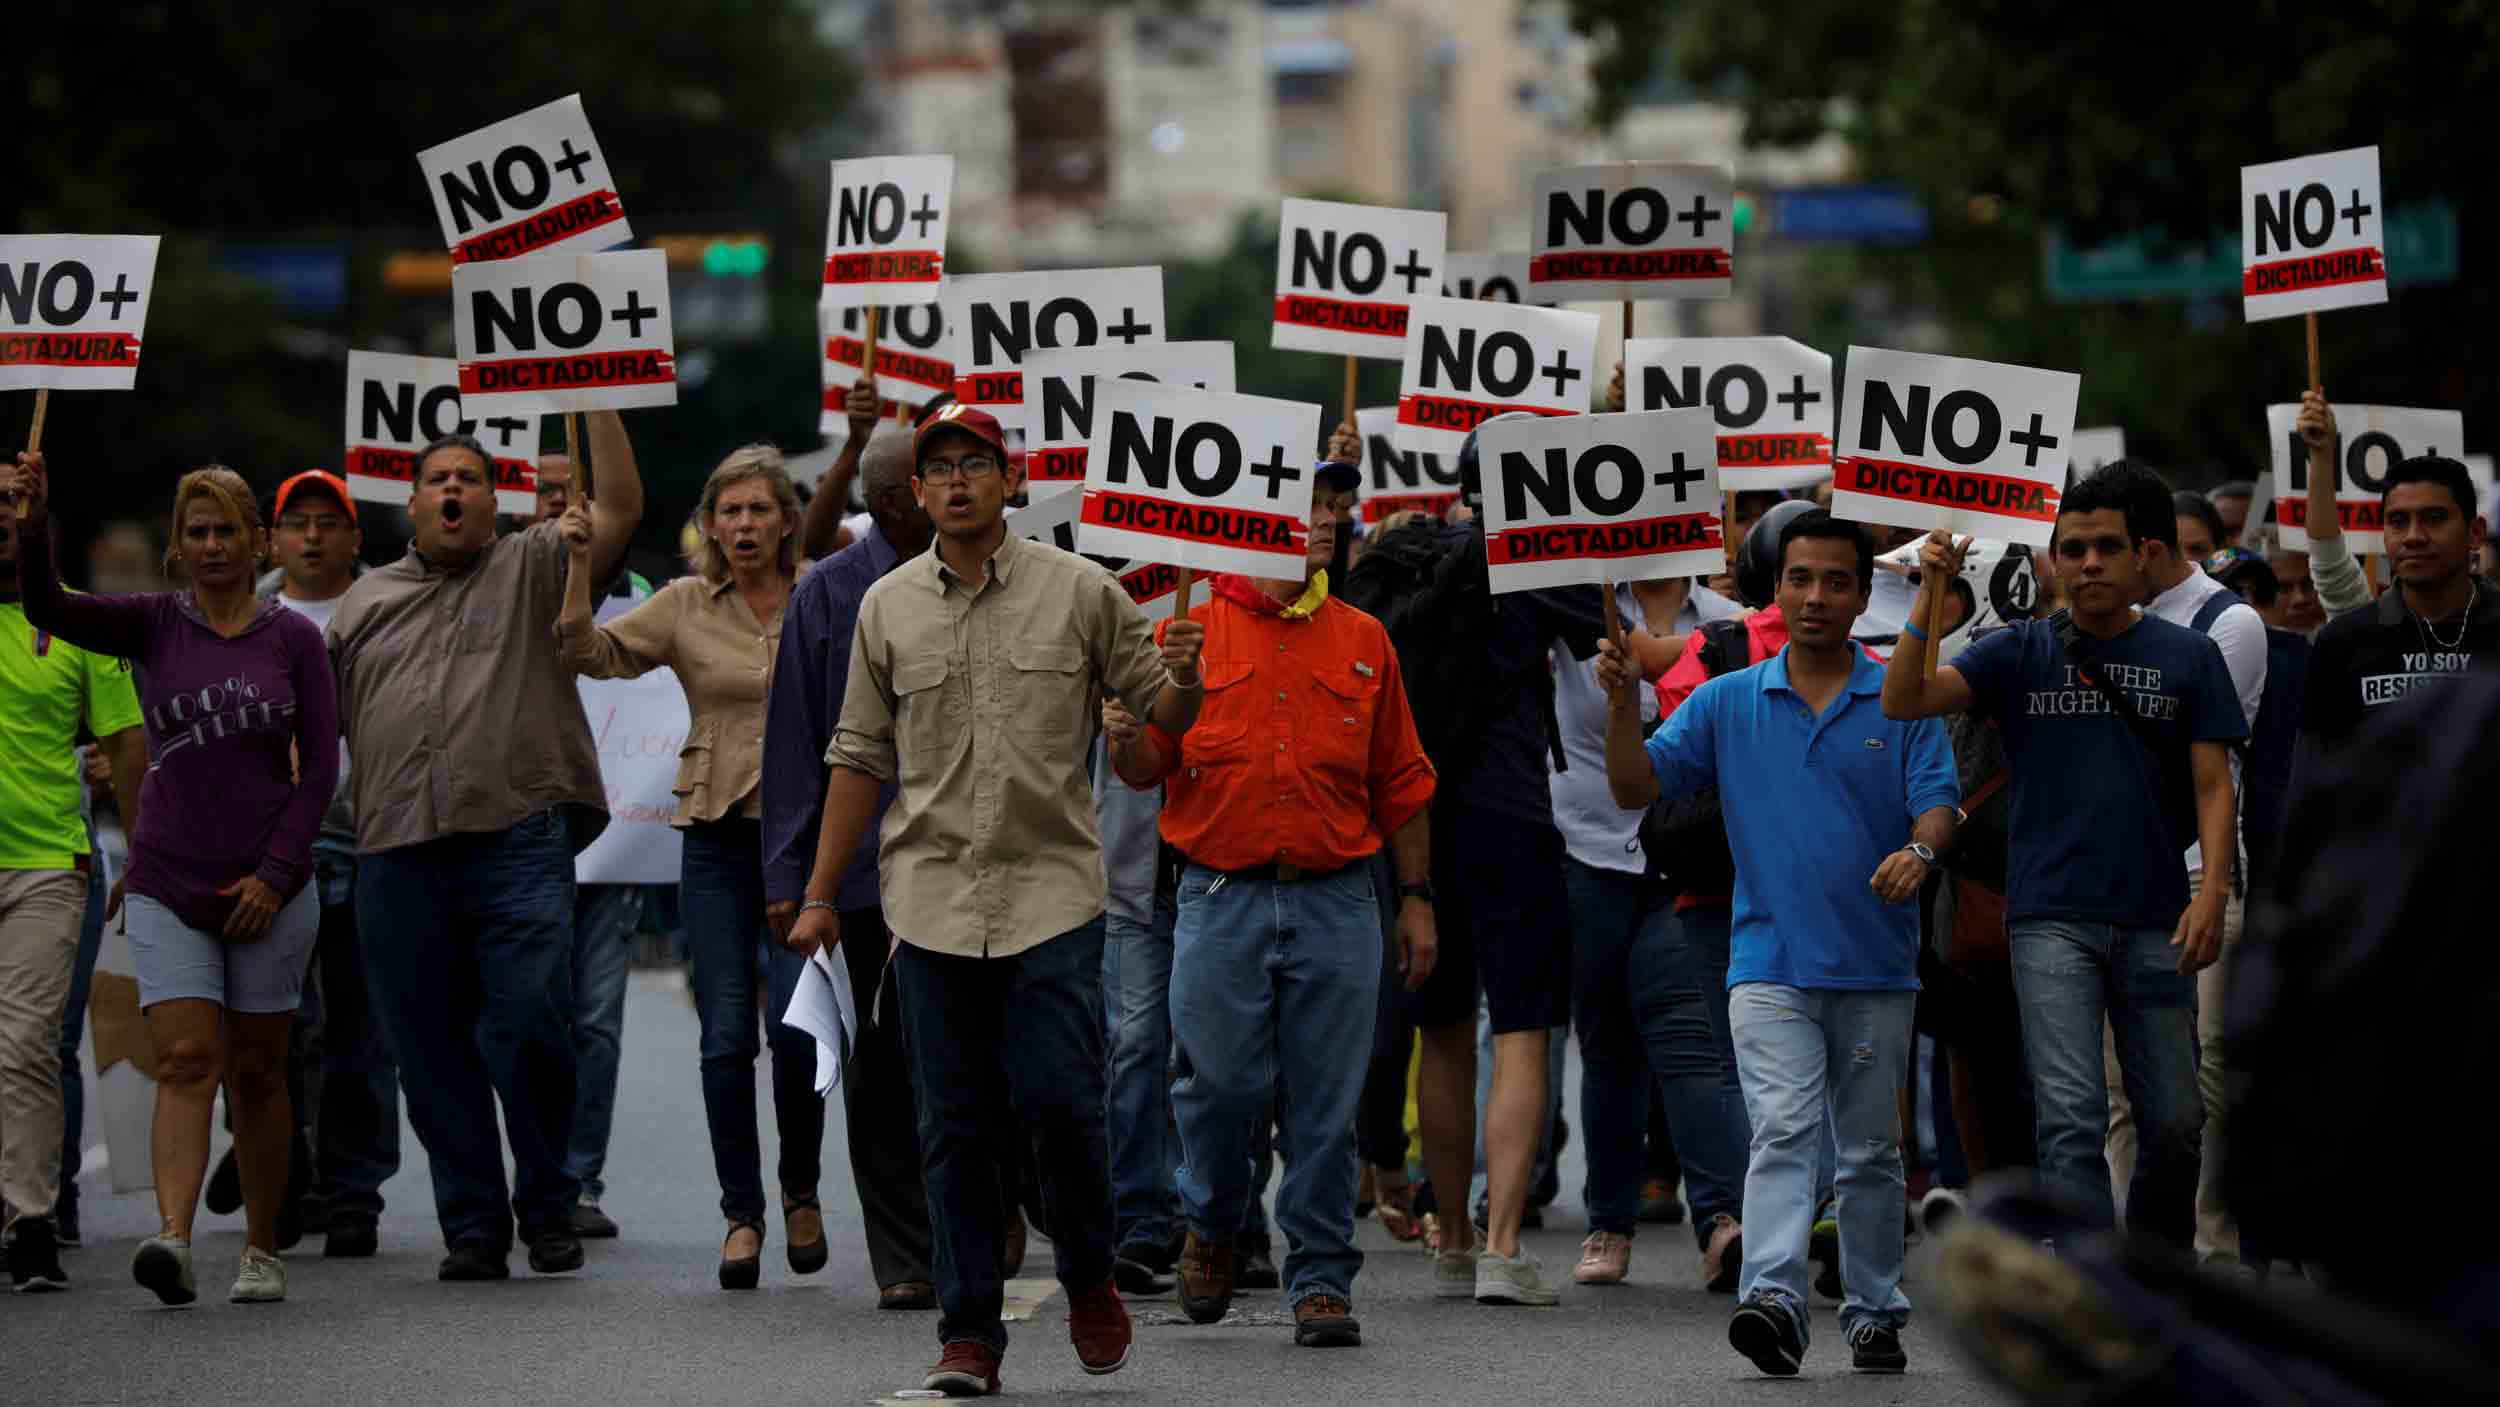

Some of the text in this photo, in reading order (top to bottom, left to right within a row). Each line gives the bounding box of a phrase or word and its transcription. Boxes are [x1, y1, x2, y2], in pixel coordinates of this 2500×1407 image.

[440, 139, 592, 234] NO+
[837, 182, 939, 246] NO+
[1547, 187, 1721, 247] NO+
[2254, 183, 2372, 256] NO+
[835, 256, 935, 281] DICTDURA
[1292, 227, 1432, 295] NO+
[1547, 253, 1717, 278] DICTADURA
[2256, 251, 2375, 291] DICTADURA
[472, 282, 657, 354] NO+
[1290, 300, 1408, 333] DICTADUR
[479, 355, 662, 389] DICTADURA
[1420, 325, 1581, 398] NO+
[1859, 379, 2058, 467] NO+
[1108, 410, 1300, 499] NO+
[1500, 444, 1705, 521] NO+
[1855, 463, 2046, 514] DICTADURA
[1103, 496, 1292, 548] DICTADURA
[1508, 520, 1708, 560] DICTADURA
[2103, 663, 2161, 691] THE
[2402, 653, 2471, 672] YO SOY
